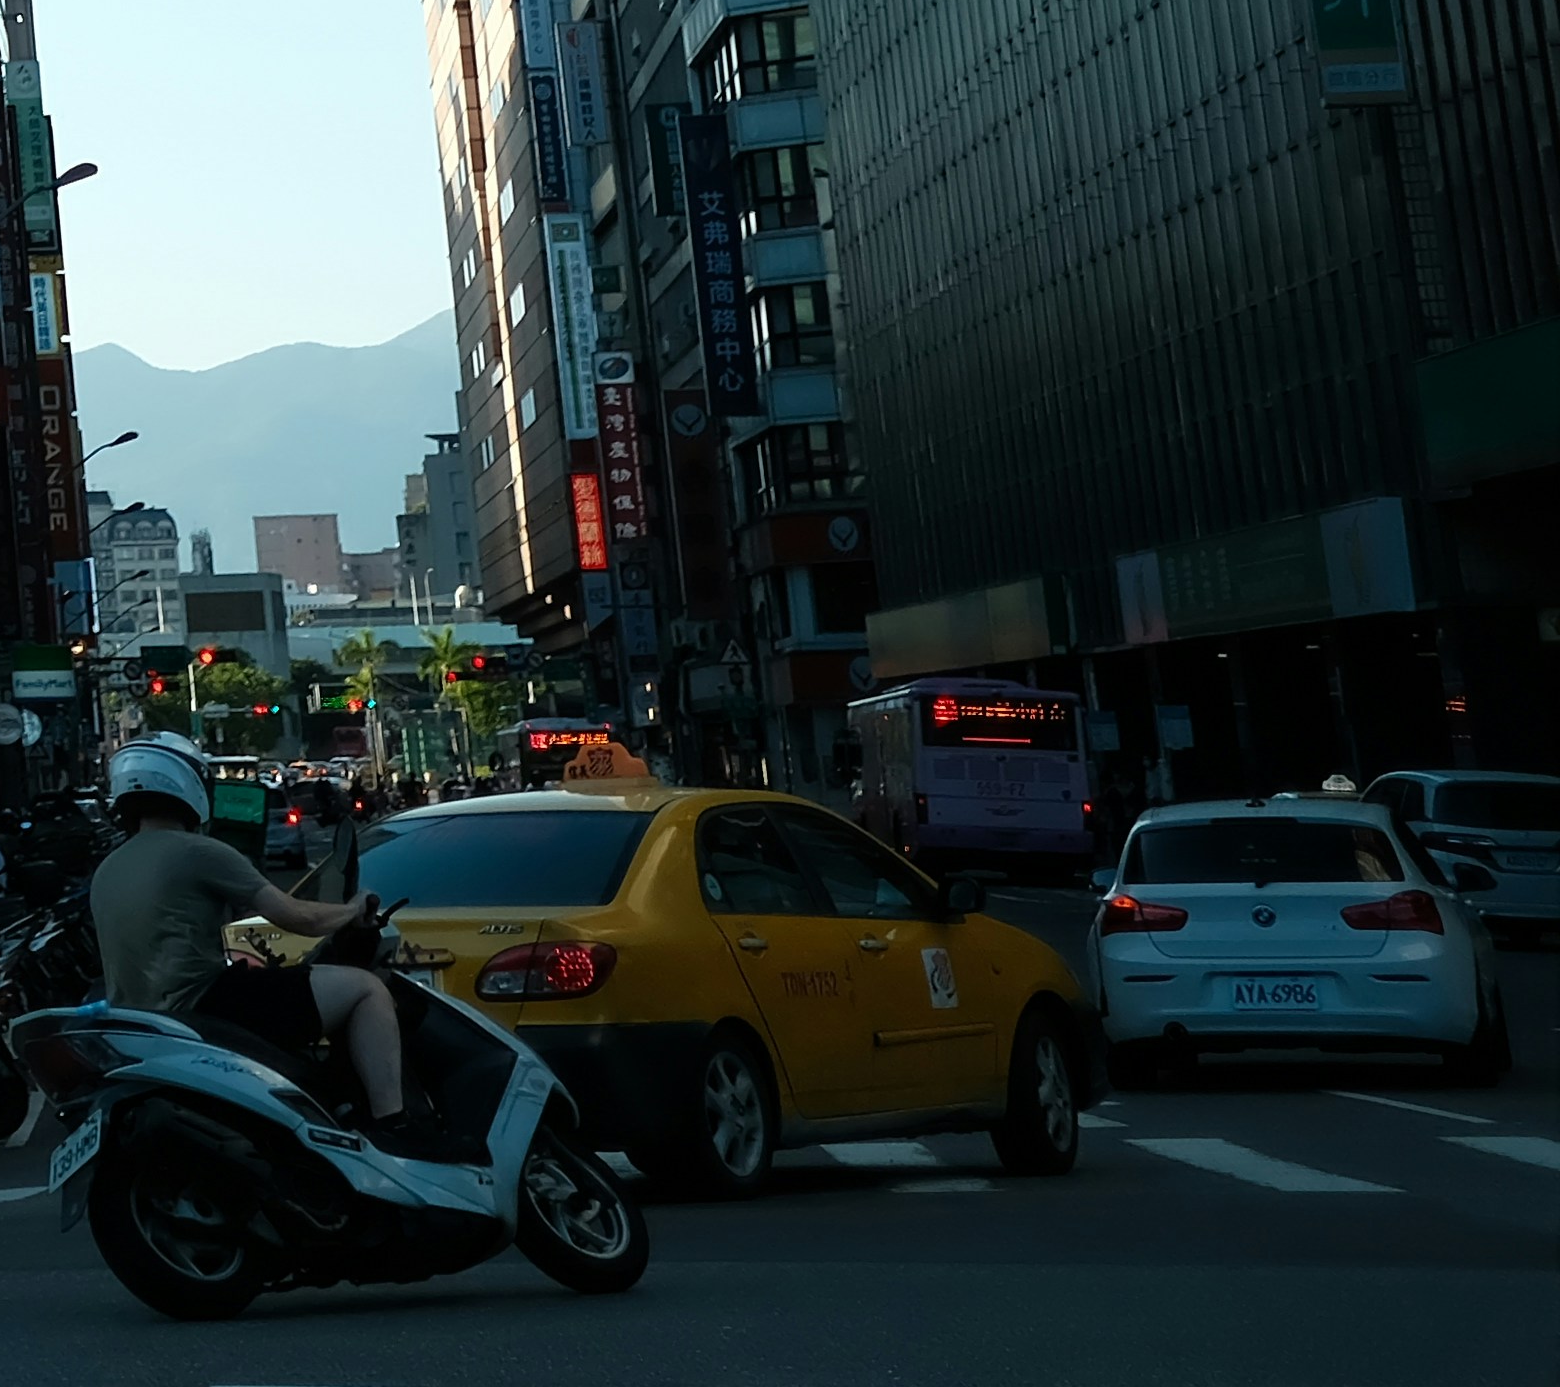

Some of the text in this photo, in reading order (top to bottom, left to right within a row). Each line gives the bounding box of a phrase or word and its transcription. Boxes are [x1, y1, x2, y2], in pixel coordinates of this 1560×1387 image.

[697, 191, 744, 392] 艾弗瑞商務中心
[40, 385, 68, 531] ORANGE
[15, 678, 72, 691] FamilyMart
[479, 924, 524, 935] ALTIS
[1233, 982, 1317, 1004] AYA-6986
